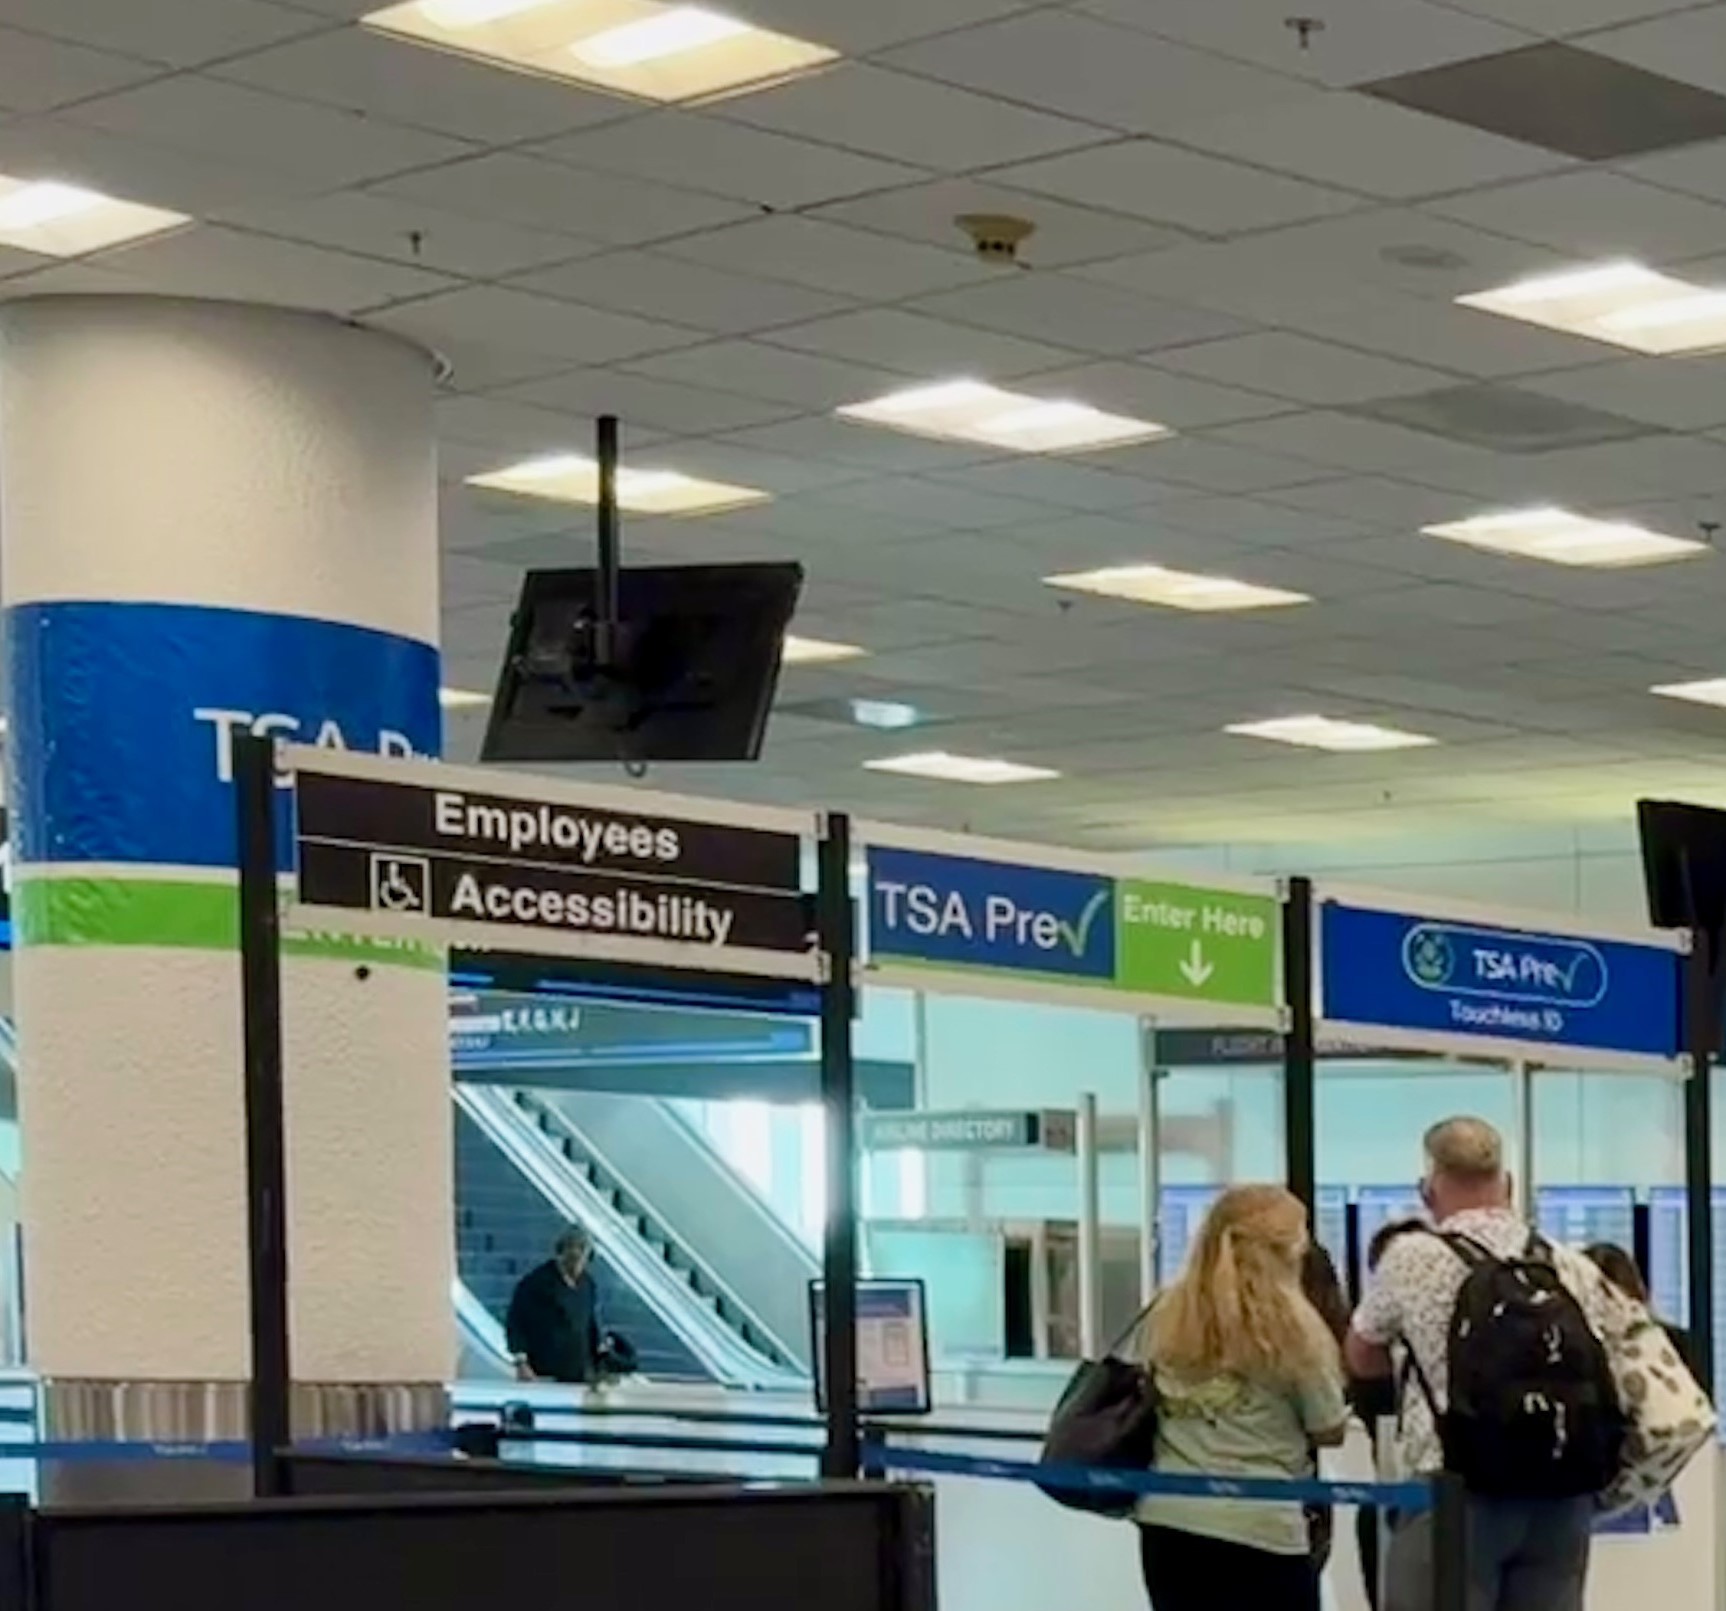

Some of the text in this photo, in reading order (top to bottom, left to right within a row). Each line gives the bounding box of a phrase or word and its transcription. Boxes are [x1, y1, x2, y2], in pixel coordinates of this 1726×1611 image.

[434, 792, 681, 864] Employees
[450, 873, 734, 946] Accessibility
[875, 882, 1059, 950] TSA Pre
[1123, 894, 1265, 940] Enter Here
[1472, 949, 1517, 981] TSA
[1449, 999, 1541, 1031] Touchless
